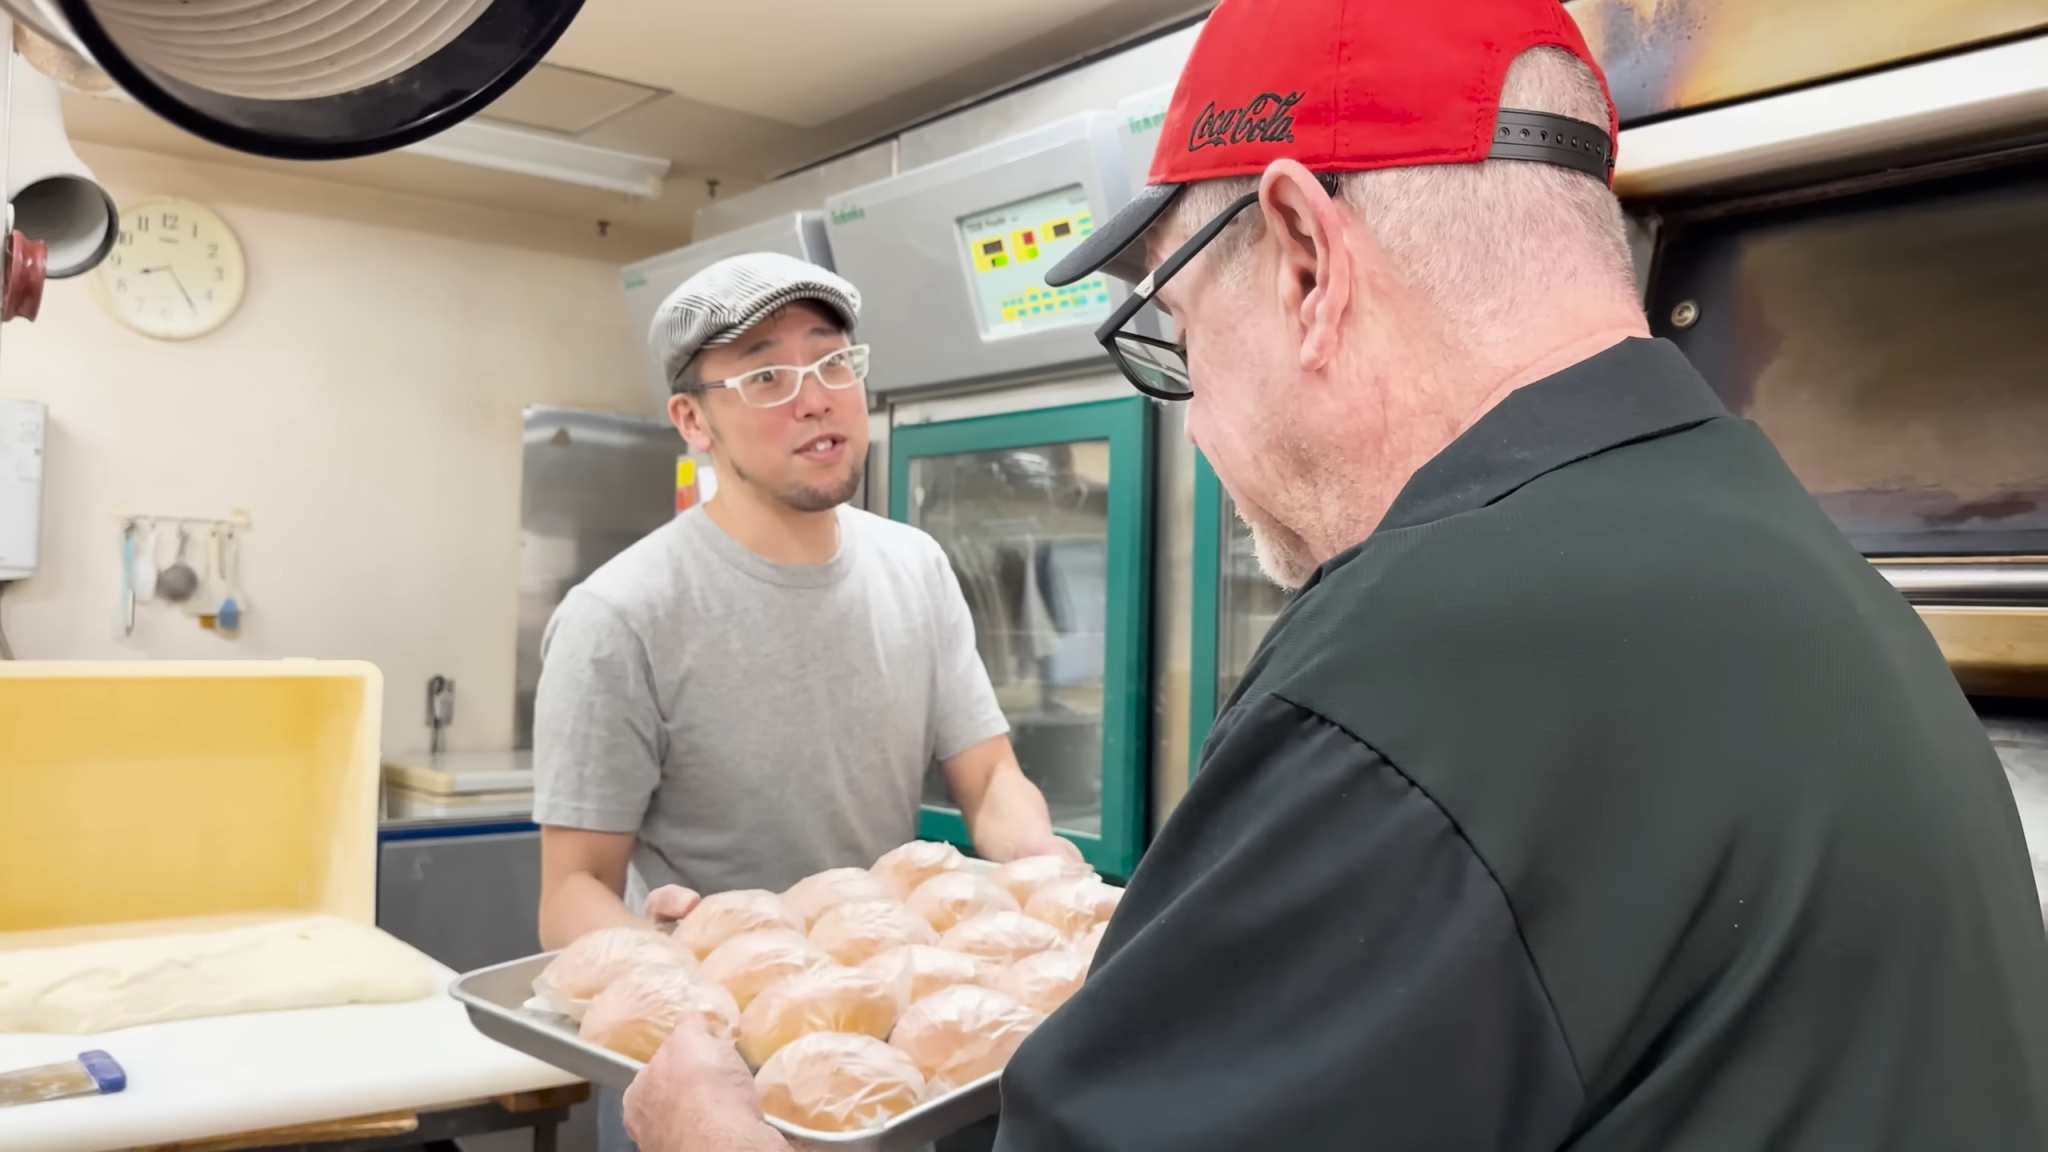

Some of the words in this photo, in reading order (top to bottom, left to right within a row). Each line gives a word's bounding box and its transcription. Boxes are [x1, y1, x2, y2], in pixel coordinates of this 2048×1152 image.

[137, 214, 149, 232] 11
[162, 212, 179, 230] 12
[119, 230, 133, 246] 10
[192, 222, 198, 239] 1
[207, 241, 219, 259] 2
